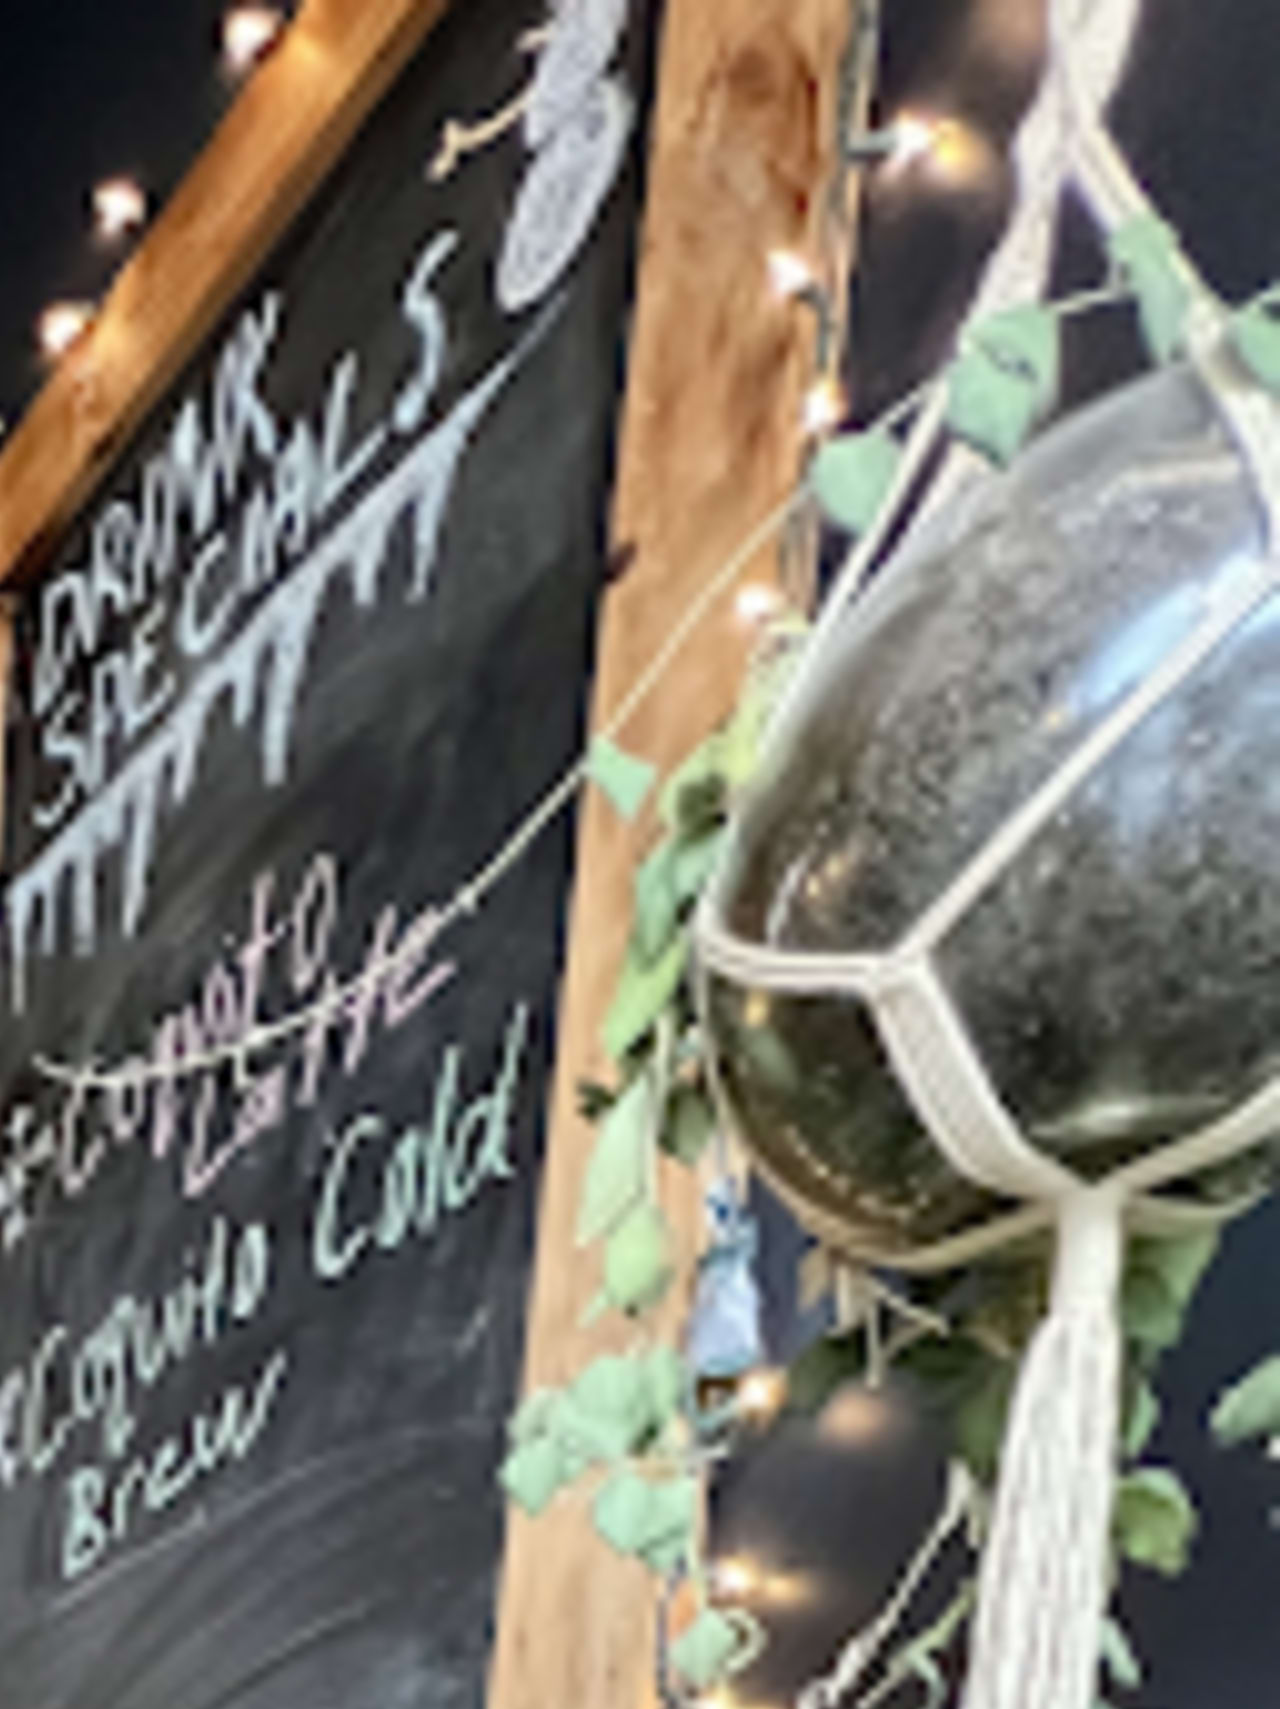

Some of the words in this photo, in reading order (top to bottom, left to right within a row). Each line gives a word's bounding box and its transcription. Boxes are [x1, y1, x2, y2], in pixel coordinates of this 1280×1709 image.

[33, 229, 459, 828] SPECIALS
[23, 1214, 269, 1471] Coquito
[313, 1000, 529, 1278] Cold
[61, 1350, 288, 1580] Brew
